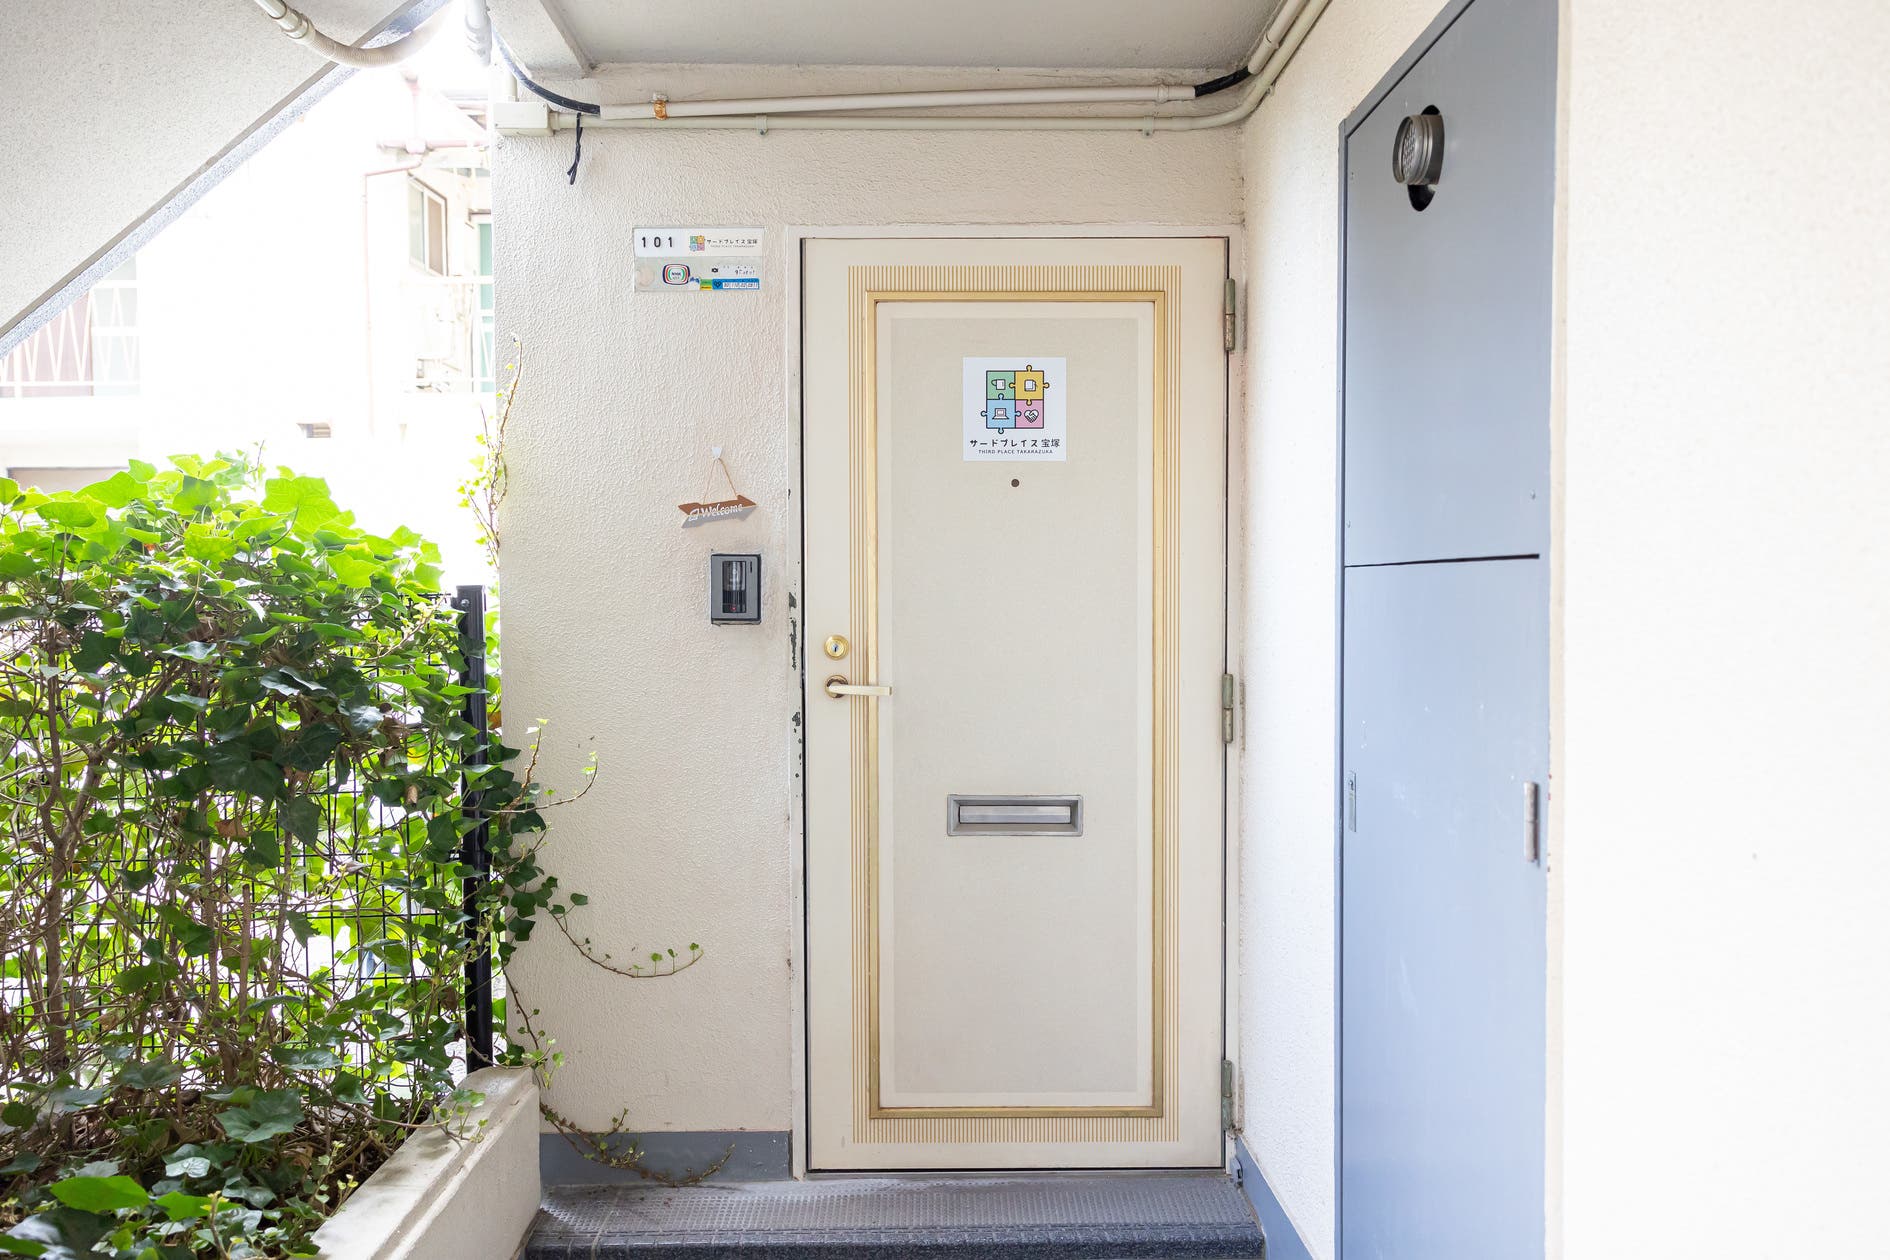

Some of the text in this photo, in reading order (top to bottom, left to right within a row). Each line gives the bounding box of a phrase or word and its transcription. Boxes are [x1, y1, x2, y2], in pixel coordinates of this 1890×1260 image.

[641, 236, 673, 248] 101
[969, 438, 1061, 448] サードプレイス宝塚
[701, 503, 743, 518] Welcome
